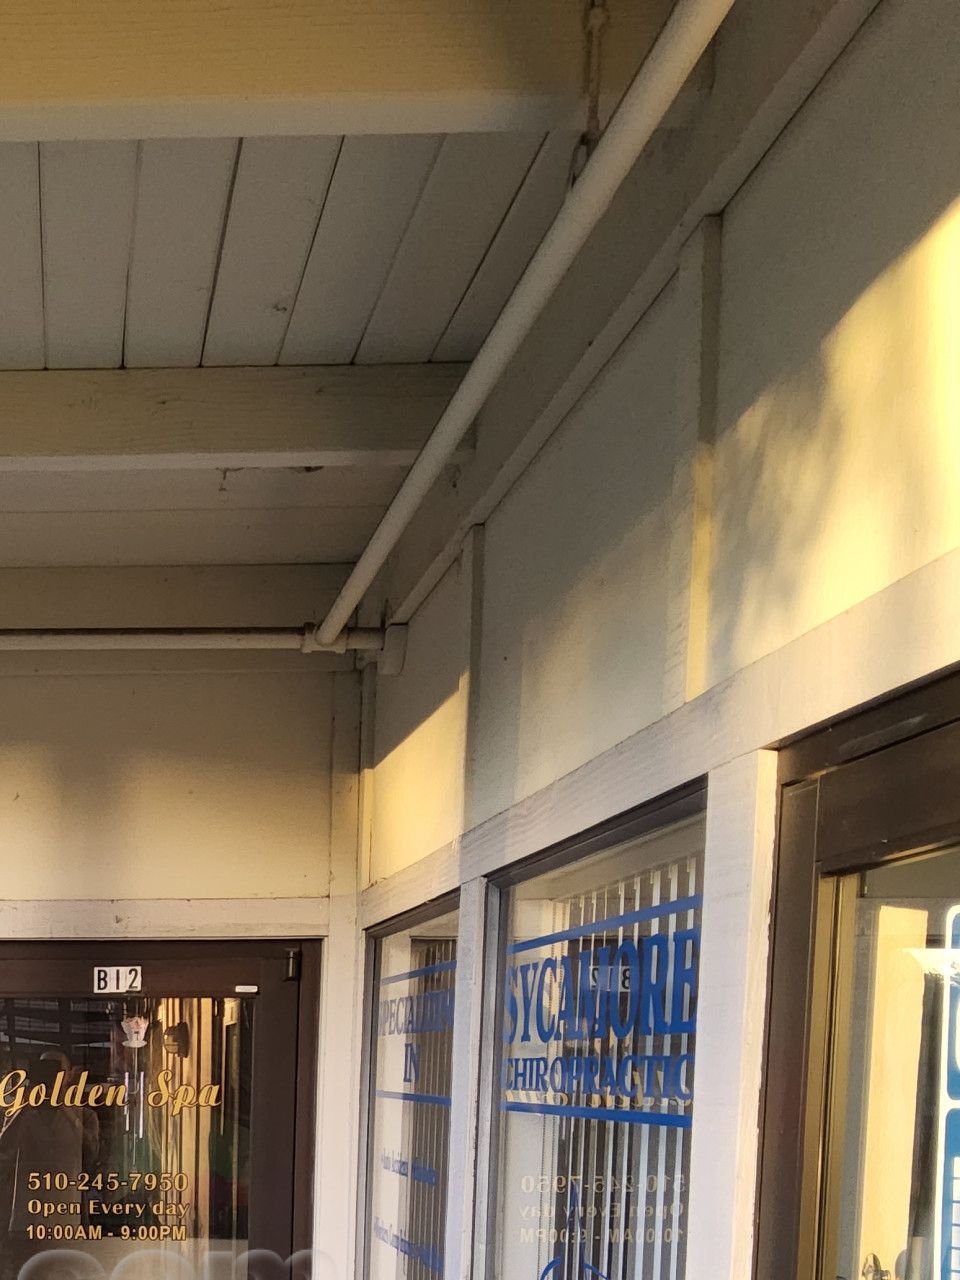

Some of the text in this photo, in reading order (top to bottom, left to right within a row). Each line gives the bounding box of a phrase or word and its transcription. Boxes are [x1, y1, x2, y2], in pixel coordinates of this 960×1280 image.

[97, 968, 138, 990] B12
[505, 927, 699, 1044] SYCAMORE
[504, 1054, 695, 1099] CHIROPRACTIC
[148, 1069, 221, 1115] Spa
[27, 1173, 188, 1191] 510-245-7950
[28, 1198, 190, 1217] Open Every day
[26, 1225, 102, 1241] 10:00AM
[121, 1225, 187, 1241] 9:00PM
